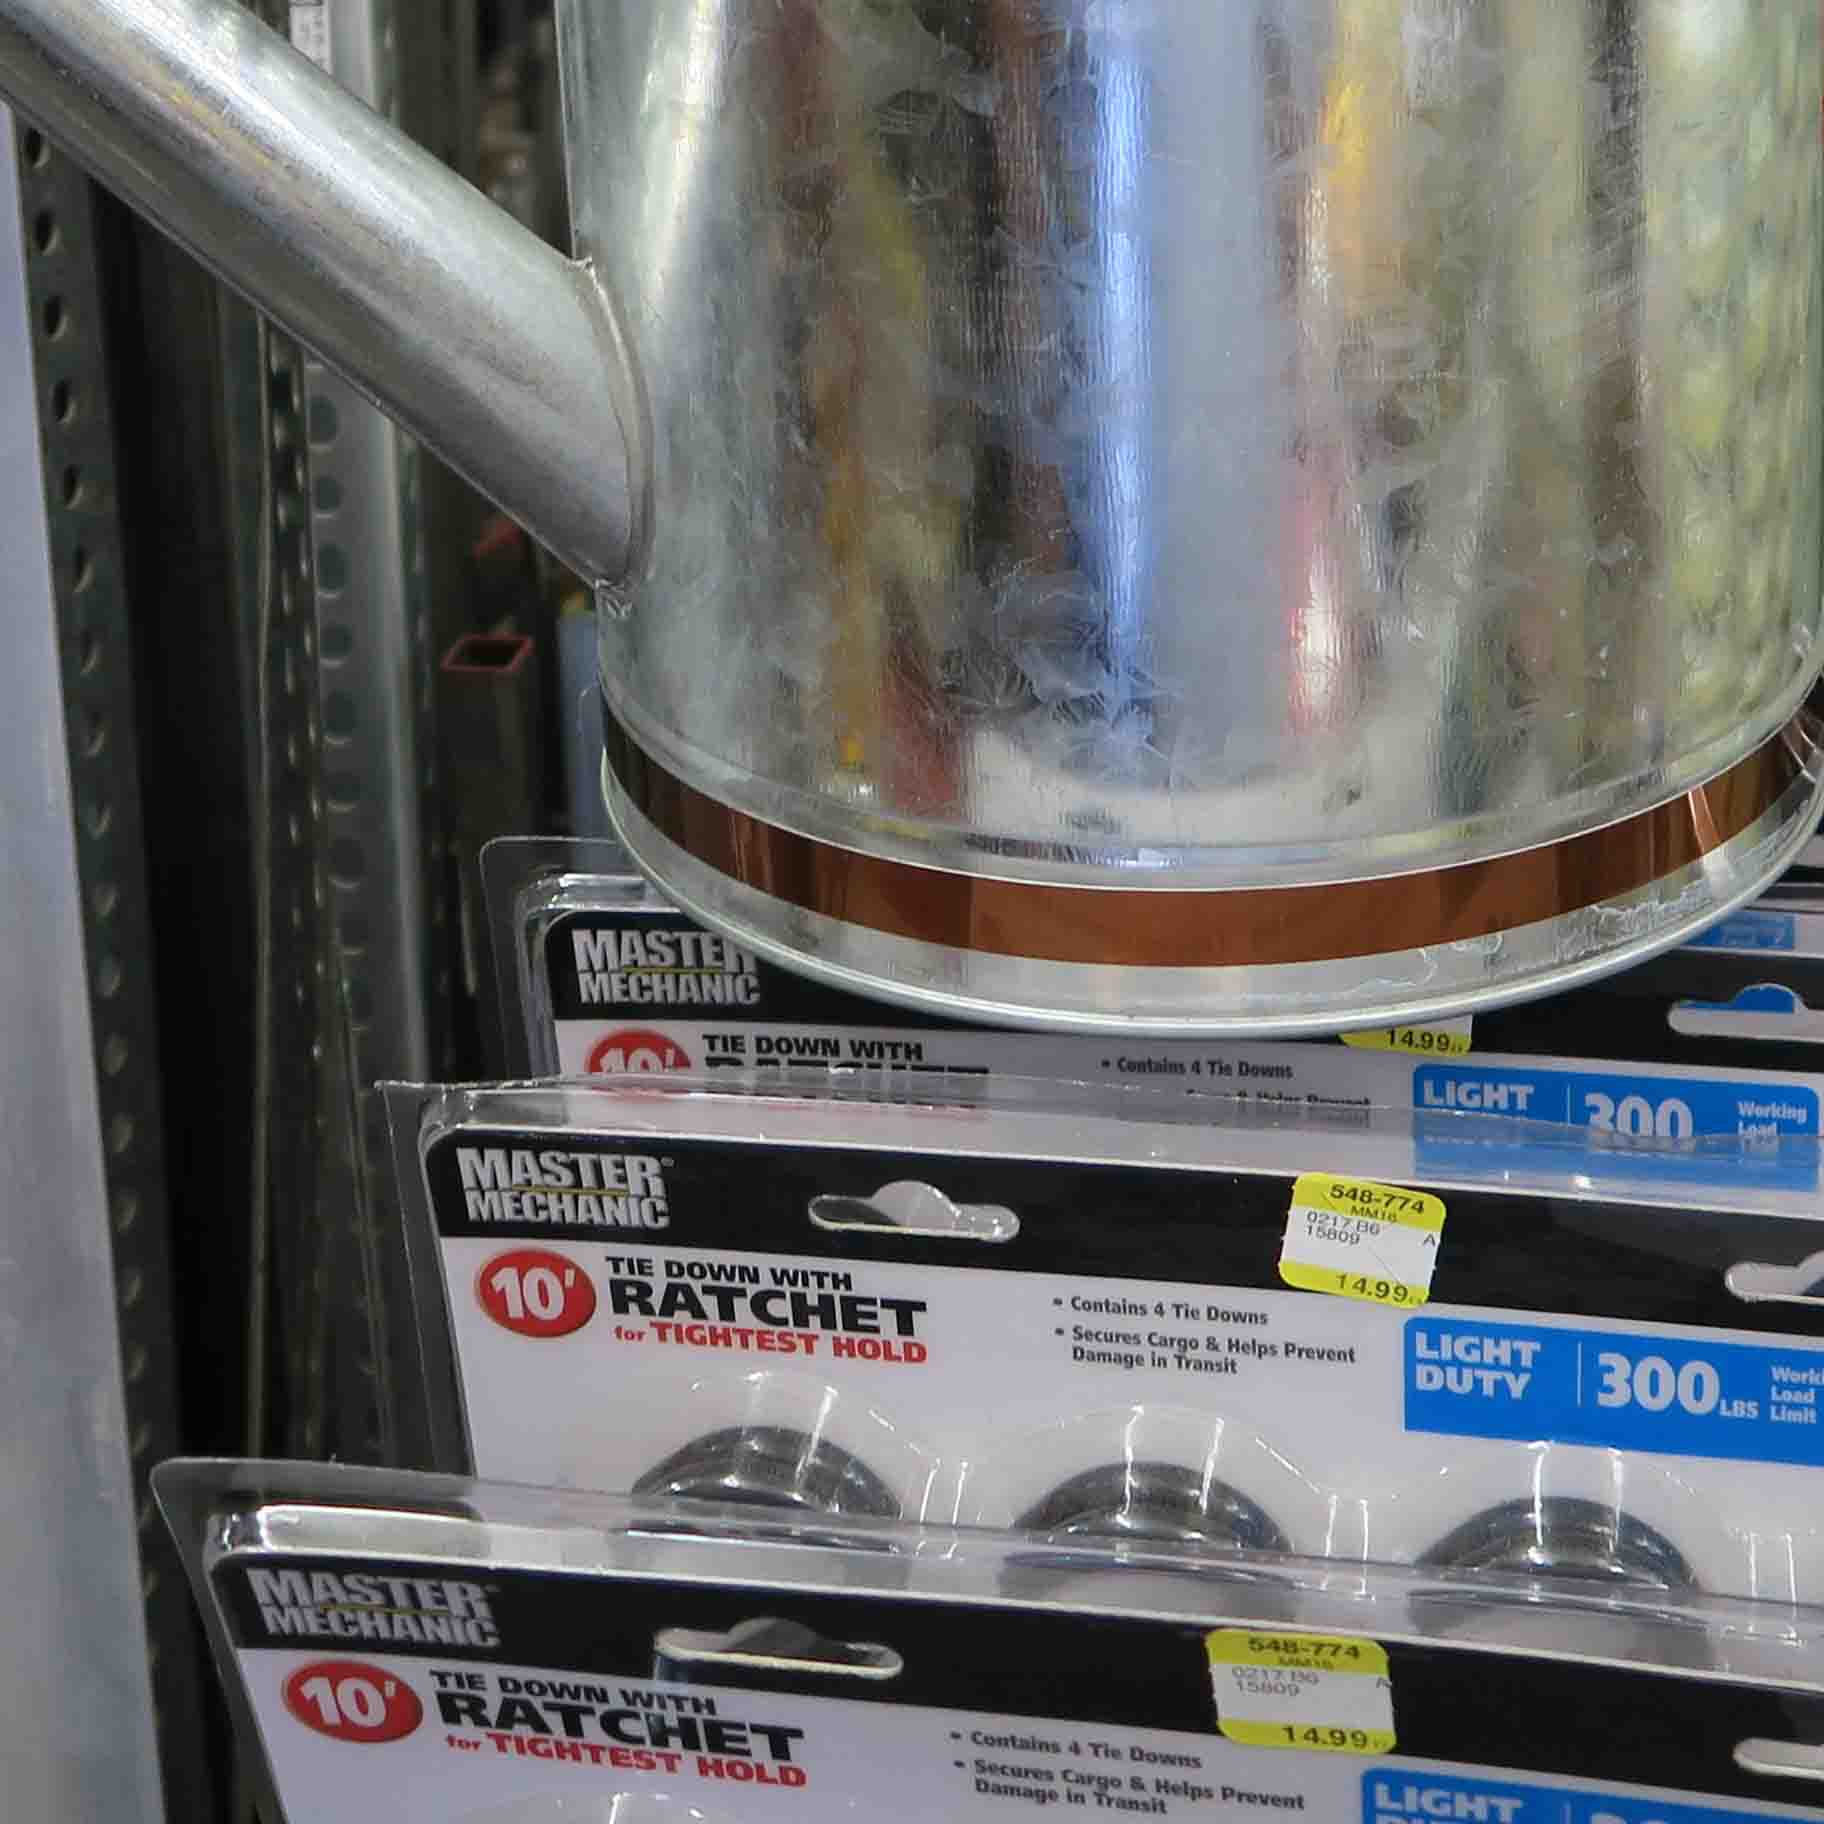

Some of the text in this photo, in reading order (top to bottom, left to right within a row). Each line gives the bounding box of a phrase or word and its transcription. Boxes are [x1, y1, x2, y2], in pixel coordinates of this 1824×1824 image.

[578, 972, 761, 1006] MECHANIC
[702, 1032, 925, 1062] TIE DOWN WITH
[1385, 1028, 1451, 1054] 14.99
[1117, 1055, 1294, 1079] Contains 4 Tie Downs
[1422, 1079, 1534, 1111] LIGHT
[1582, 1090, 1695, 1138] 300
[1736, 1099, 1808, 1125] Working
[455, 1146, 666, 1197] MASTER
[464, 1188, 672, 1229] MECHANIC
[1329, 1183, 1426, 1215] 548-774
[1306, 1210, 1352, 1229] 0217
[1306, 1225, 1437, 1247] 15809 A
[605, 1255, 854, 1292] TIE DOWN WITH
[1336, 1274, 1409, 1304] 14.99
[489, 1266, 576, 1322] 10'
[609, 1277, 928, 1338] RATCHET
[1070, 1295, 1269, 1326] Contains 4 Tie Downs
[614, 1320, 928, 1365] for TIGHTEST HOLD
[1071, 1325, 1357, 1366] Secures Cargo & Helps Prevent
[1072, 1346, 1239, 1376] Damage in Transit
[1414, 1330, 1542, 1370] LIGHT
[1414, 1362, 1533, 1401] DUTY
[1596, 1351, 1760, 1421] 300 LBS
[1770, 1387, 1816, 1405] Load
[1769, 1406, 1818, 1426] Limit
[245, 1566, 492, 1620] MASTER
[262, 1607, 502, 1649] MECHANIC
[1248, 1636, 1362, 1660] 548-774
[300, 1677, 398, 1730] 10'
[429, 1670, 718, 1717] TIE DOWN WITH
[434, 1691, 807, 1763] RATCHET
[1282, 1724, 1369, 1749] 14.99
[445, 1731, 809, 1789] for TIGHTEST HOLD
[970, 1730, 1204, 1770] Contains 4 Tie Downs
[973, 1759, 1306, 1812] Secures Cargo & Helps Prevent
[975, 1778, 1168, 1816] Damage in Transit
[1375, 1782, 1525, 1824] LIGHT
